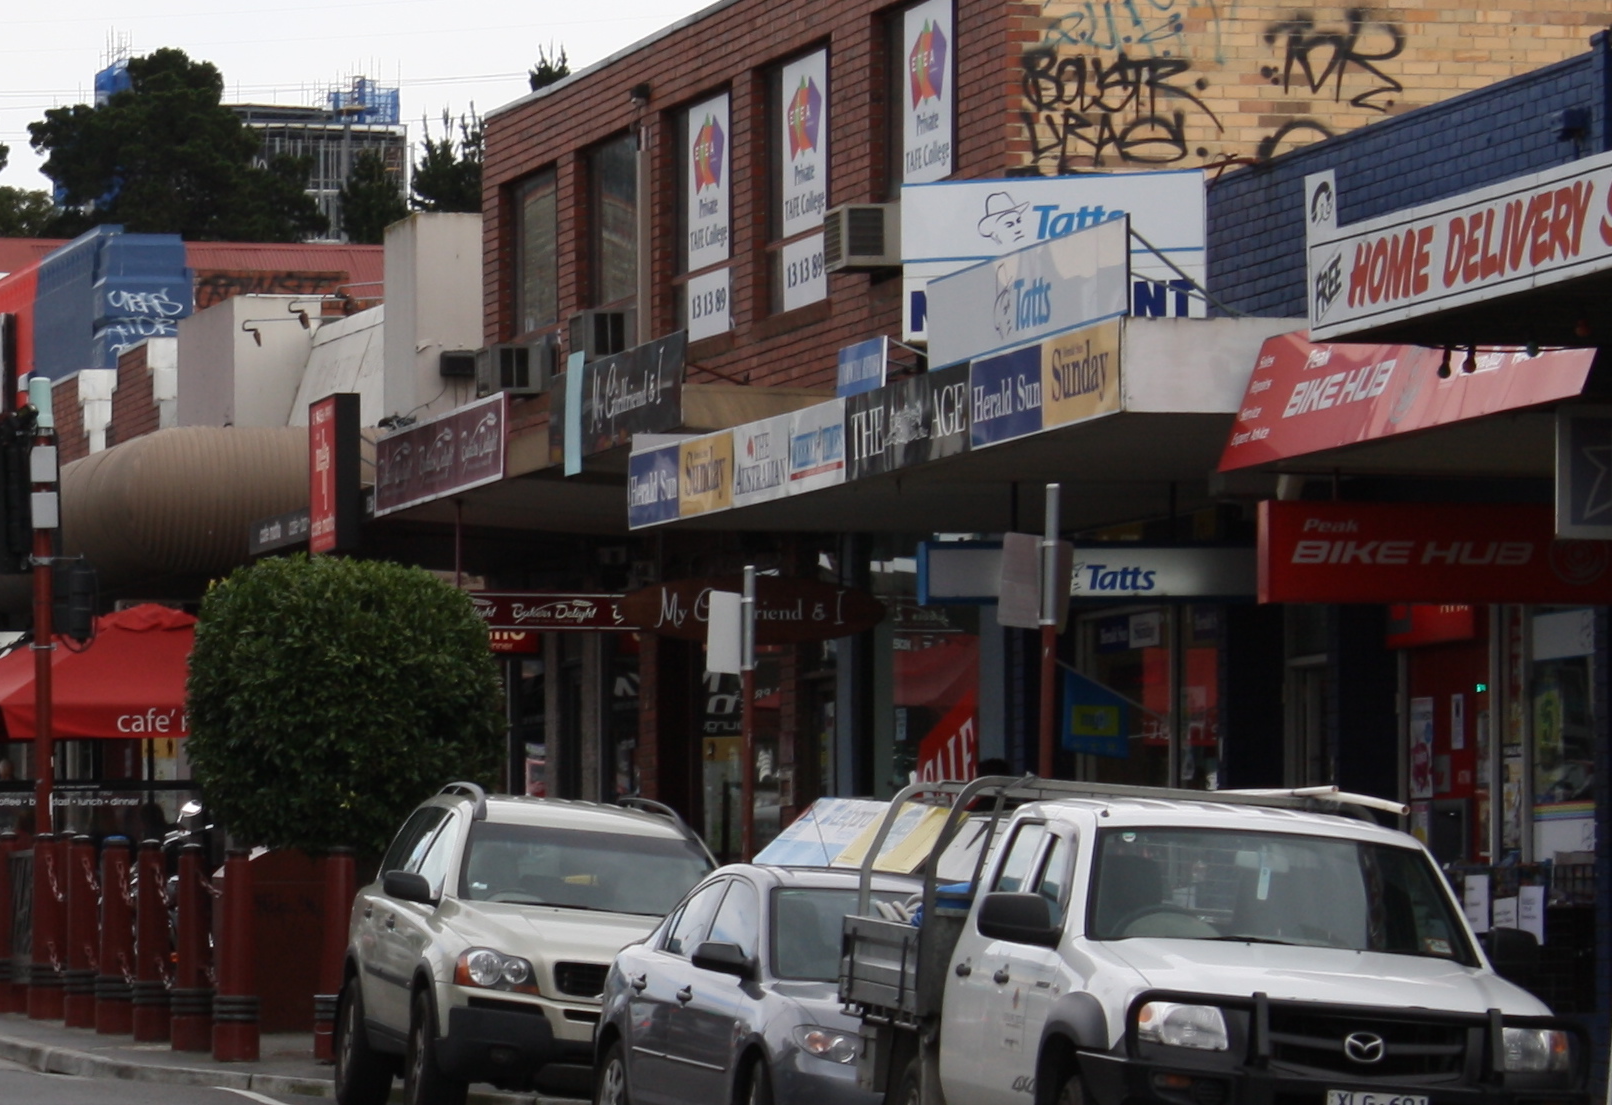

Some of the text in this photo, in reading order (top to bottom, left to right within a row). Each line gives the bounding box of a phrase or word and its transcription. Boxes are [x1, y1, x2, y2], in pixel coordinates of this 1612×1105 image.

[916, 112, 939, 137] Private
[906, 140, 950, 174] TAFE College
[794, 164, 815, 187] Private
[698, 196, 719, 219] Private
[785, 190, 826, 222] TAFE College
[1033, 204, 1125, 240] Tatt
[690, 225, 728, 253] TAFE College
[1316, 180, 1594, 322] FREE HOME DELIVERY
[787, 252, 823, 290] 13 13 89
[692, 287, 726, 320] 13 13 89
[1013, 277, 1052, 332] Tatts
[1051, 340, 1108, 402] Sunday
[1303, 345, 1333, 371] Peak
[973, 374, 1042, 424] Herald Sun
[1282, 359, 1397, 419] BIKE HUB
[930, 383, 966, 440] AGE
[1239, 407, 1263, 422] Service
[851, 406, 884, 460] THE
[1231, 427, 1270, 447] Expert Advice
[631, 469, 678, 508] Herald Sun
[685, 446, 726, 500] Sunday
[1303, 518, 1359, 532] Peak
[1291, 541, 1535, 565] BIKE HUB
[1086, 564, 1156, 590] Tatts
[555, 604, 598, 624] Delight
[653, 587, 687, 629] My
[812, 601, 826, 620] &
